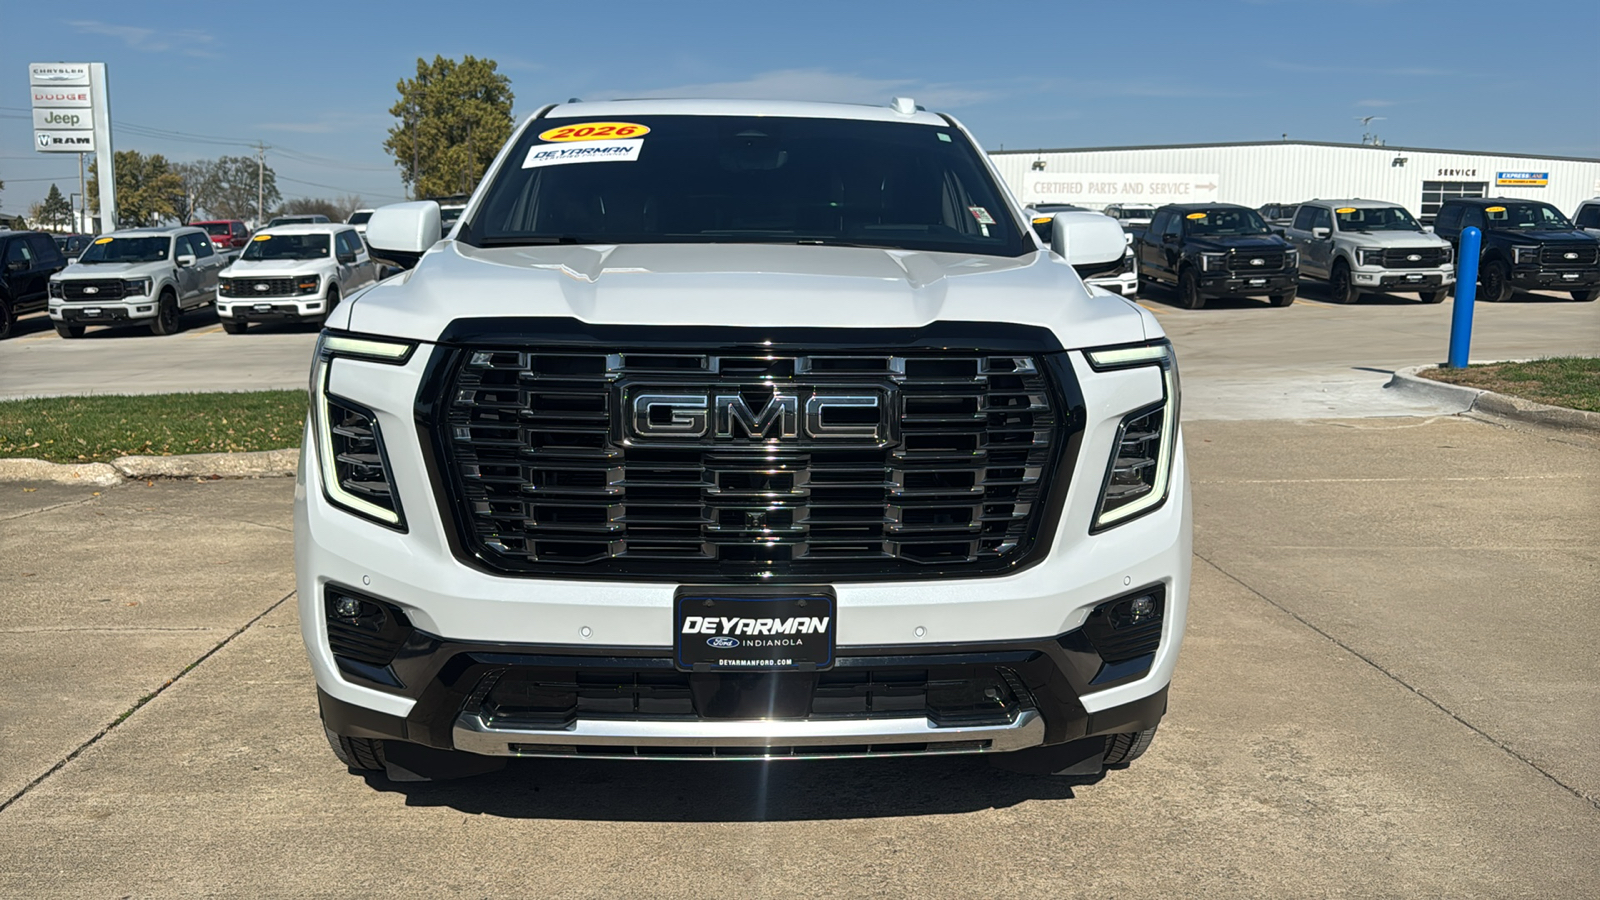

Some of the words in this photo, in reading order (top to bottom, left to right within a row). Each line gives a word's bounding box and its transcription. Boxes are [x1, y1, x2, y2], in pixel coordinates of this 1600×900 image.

[34, 93, 87, 101] DODGE
[44, 111, 80, 126] Jeep
[550, 126, 638, 139] 2026
[533, 146, 634, 158] DEYARMAN
[1033, 181, 1083, 194] CERTIFIED
[1088, 182, 1117, 194] PARTS
[1121, 182, 1143, 194] AND
[1149, 182, 1190, 194] SERVICE
[633, 394, 878, 438] GMC
[681, 616, 830, 635] DEYARMAN
[712, 637, 734, 647] Ford
[742, 638, 803, 647] INDIANOLA
[719, 658, 792, 666] DEYARMANFORD.COM
